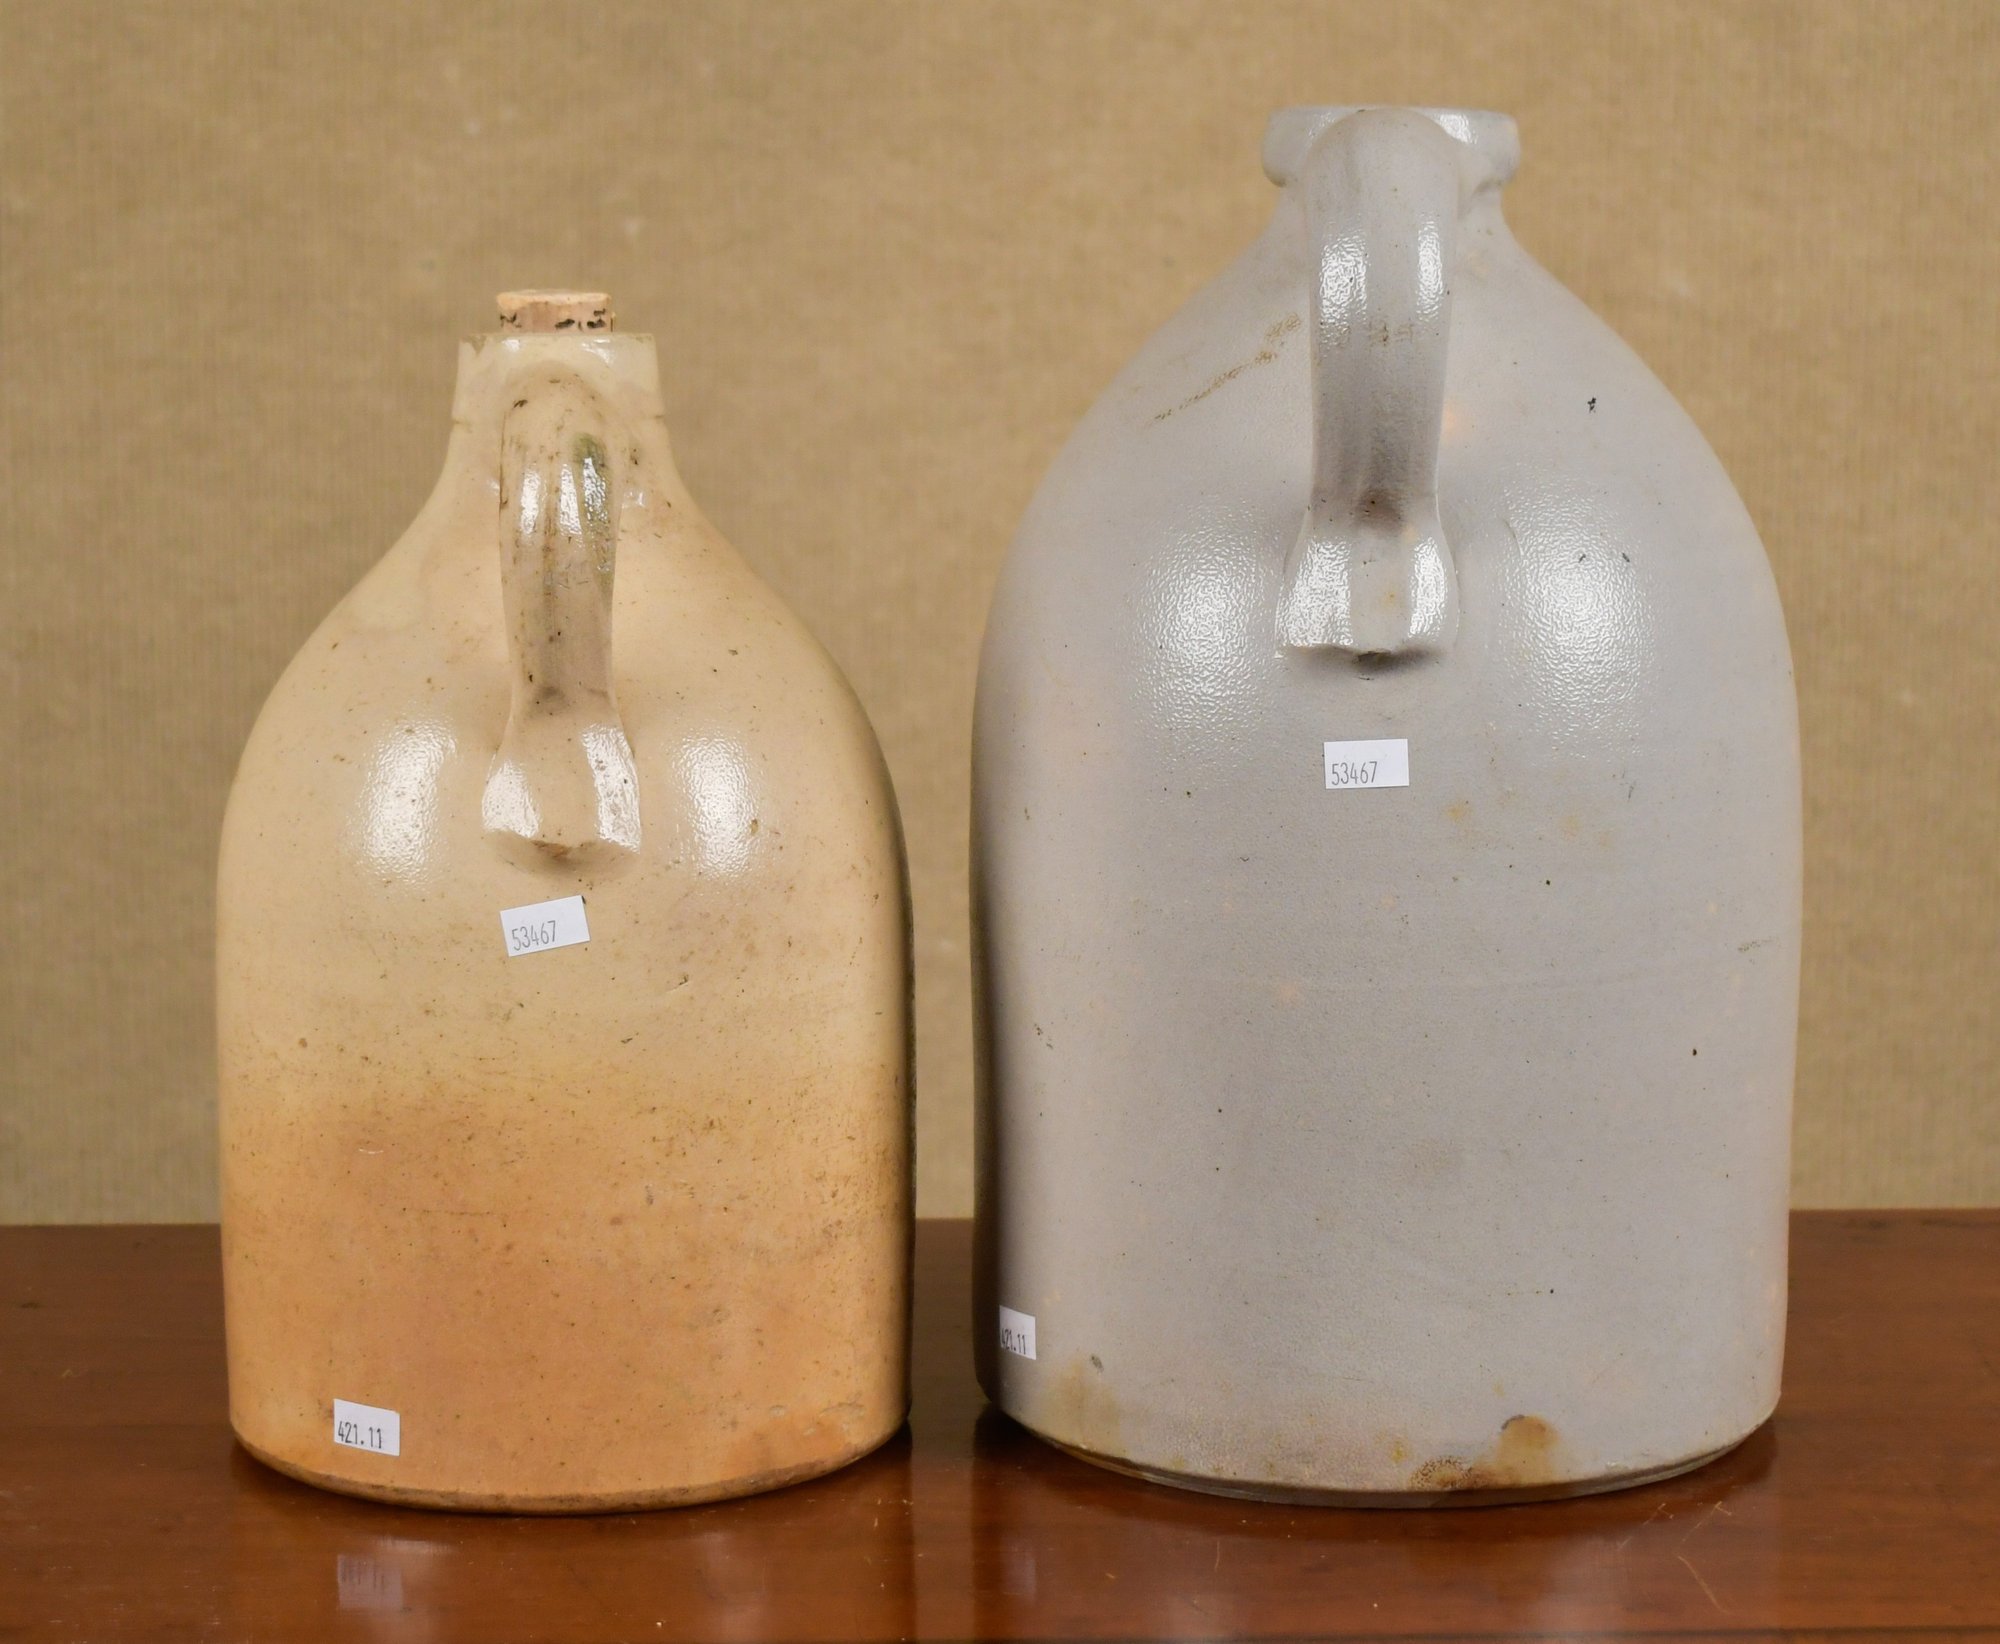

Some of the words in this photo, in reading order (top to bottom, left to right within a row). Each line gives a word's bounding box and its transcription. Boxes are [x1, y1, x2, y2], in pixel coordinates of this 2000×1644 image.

[1331, 761, 1377, 786] 53467
[511, 920, 556, 951] 53467
[338, 1421, 382, 1449] 421.11
